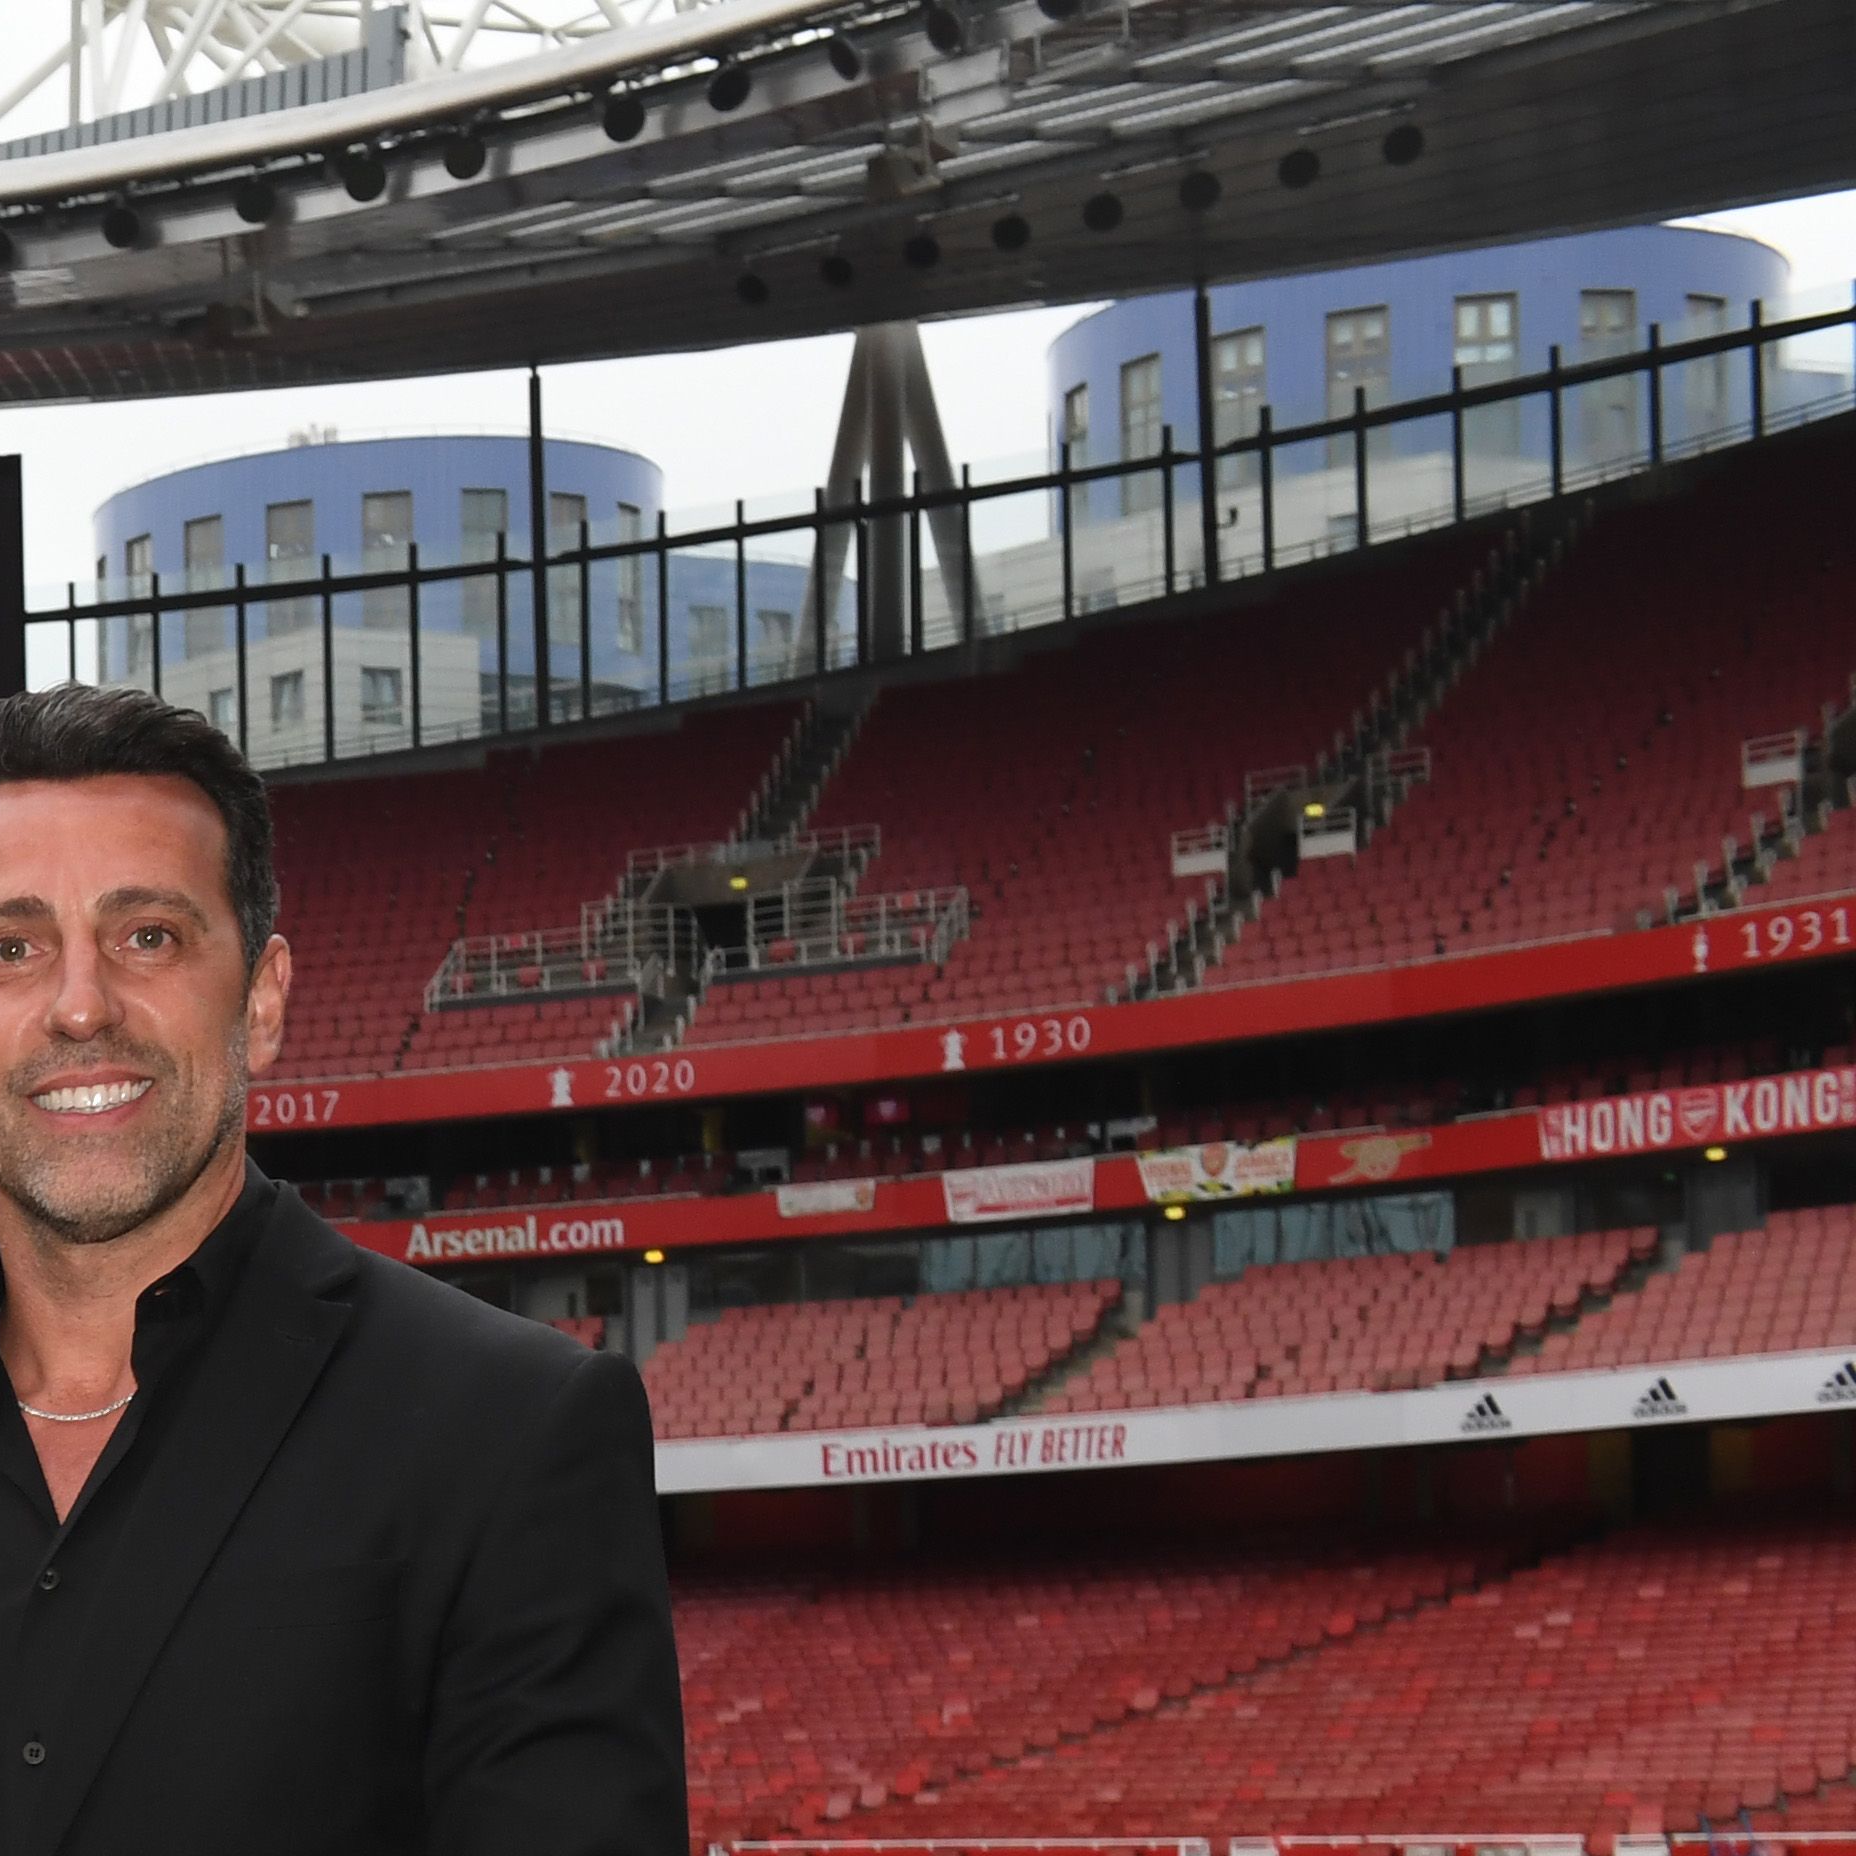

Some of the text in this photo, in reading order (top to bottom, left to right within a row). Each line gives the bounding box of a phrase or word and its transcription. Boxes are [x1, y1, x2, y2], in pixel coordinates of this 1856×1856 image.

[1740, 907, 1850, 959] 1931
[990, 1015, 1091, 1060] 1930
[605, 1059, 695, 1097] 2020
[254, 1090, 340, 1125] 2017
[1562, 1093, 1672, 1155] HONG
[1723, 1071, 1838, 1136] KONG
[405, 1214, 625, 1261] Arsenal.com
[821, 1424, 1127, 1477] Emirates FLY BETTER
